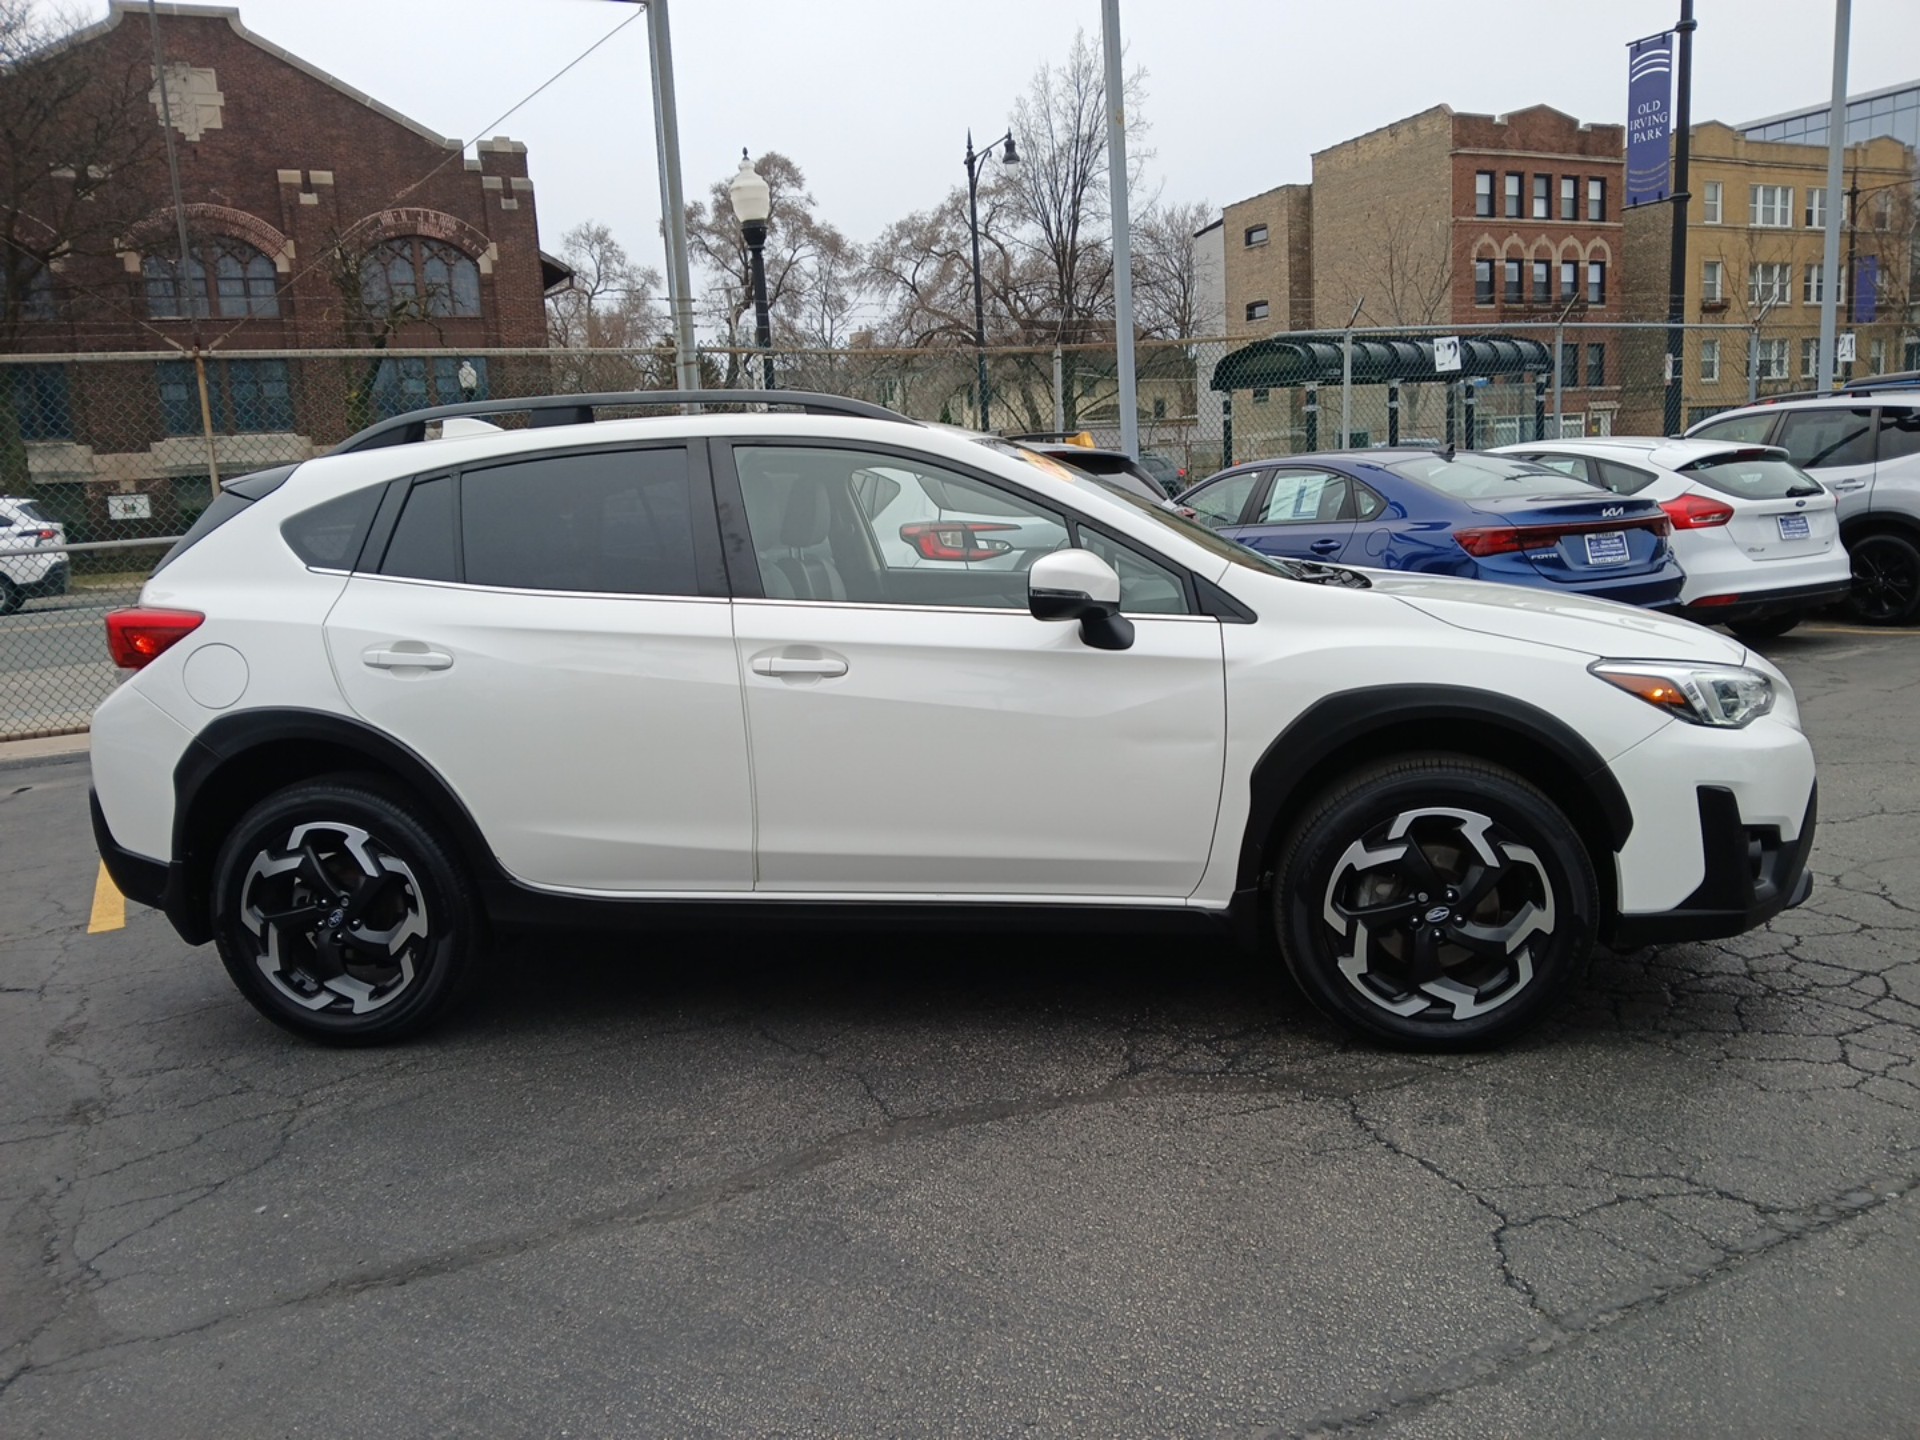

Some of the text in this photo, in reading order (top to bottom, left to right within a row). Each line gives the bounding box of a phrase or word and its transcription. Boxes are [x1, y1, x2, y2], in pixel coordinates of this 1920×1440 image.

[1638, 100, 1660, 115] OLD
[1630, 111, 1668, 131] IRVING
[1633, 126, 1662, 144] PARK
[1531, 552, 1558, 560] FORTE
